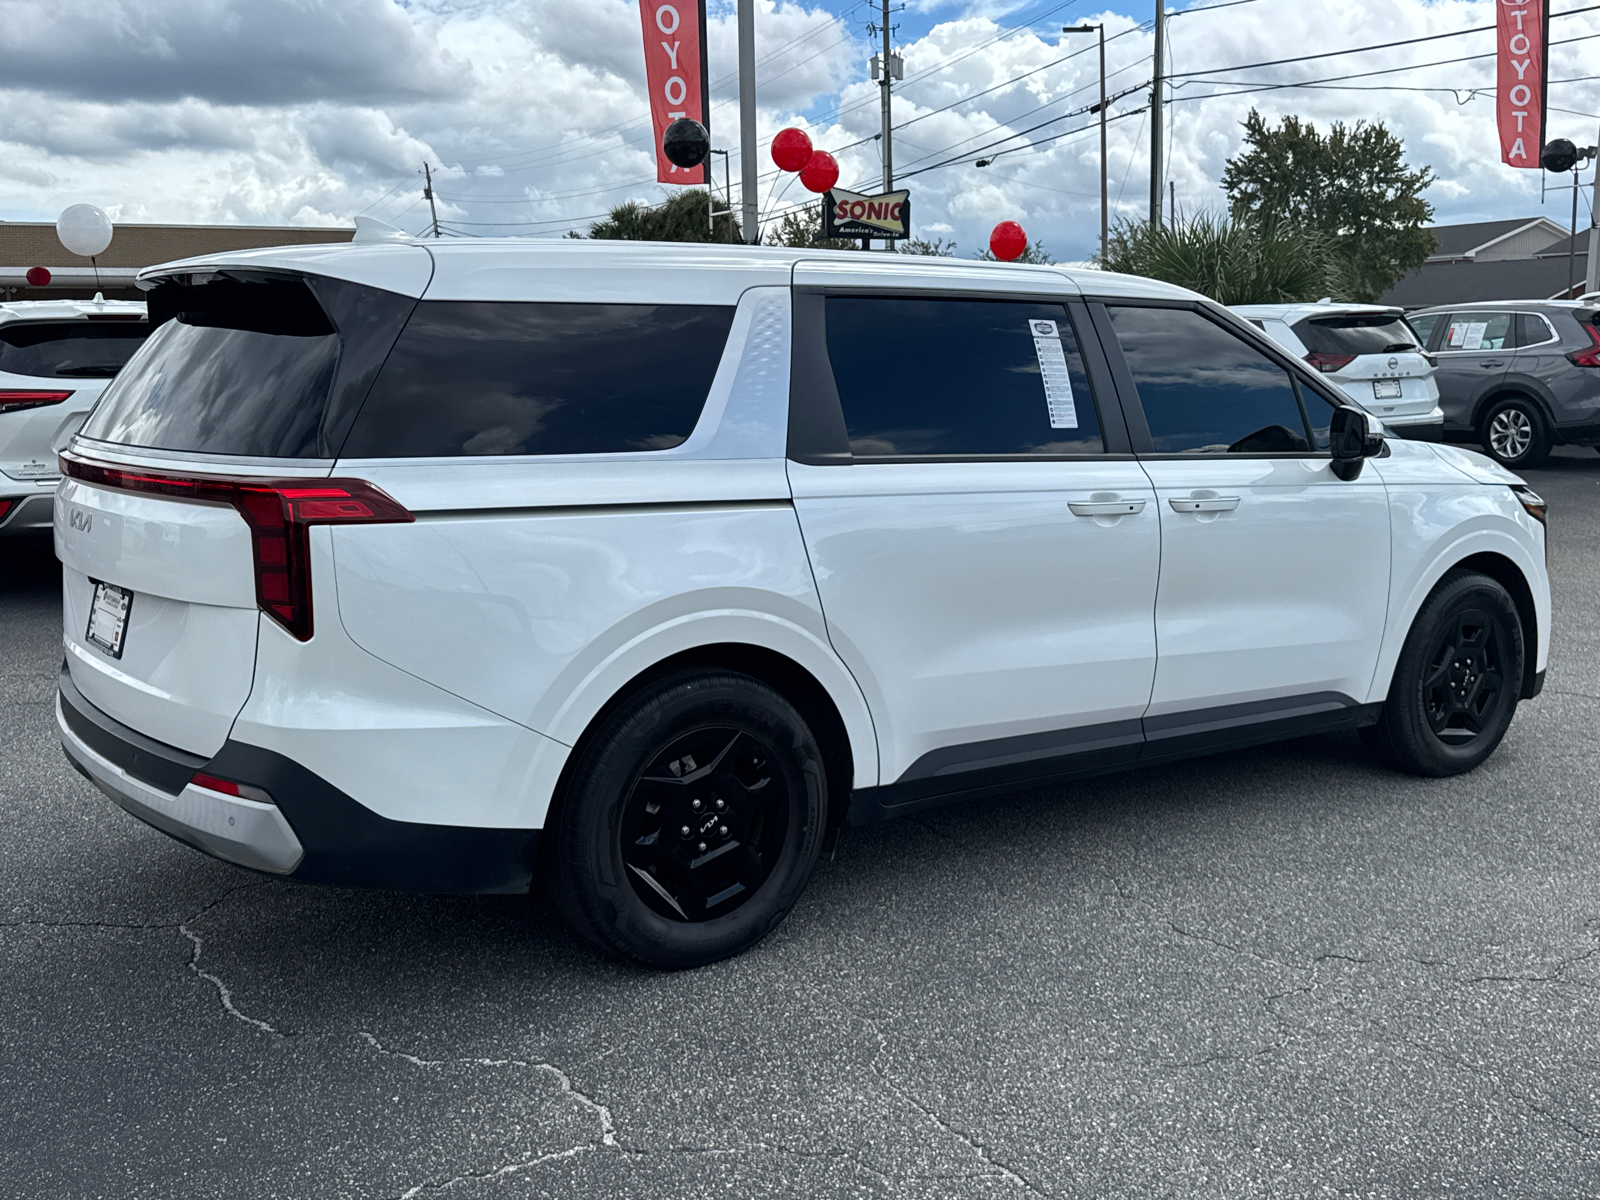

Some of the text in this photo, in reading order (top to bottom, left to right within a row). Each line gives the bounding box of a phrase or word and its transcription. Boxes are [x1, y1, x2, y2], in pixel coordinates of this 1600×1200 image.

[1508, 9, 1531, 159] TOYOTA
[836, 199, 903, 221] SONIC
[838, 226, 874, 234] America's
[69, 507, 93, 533] KIA
